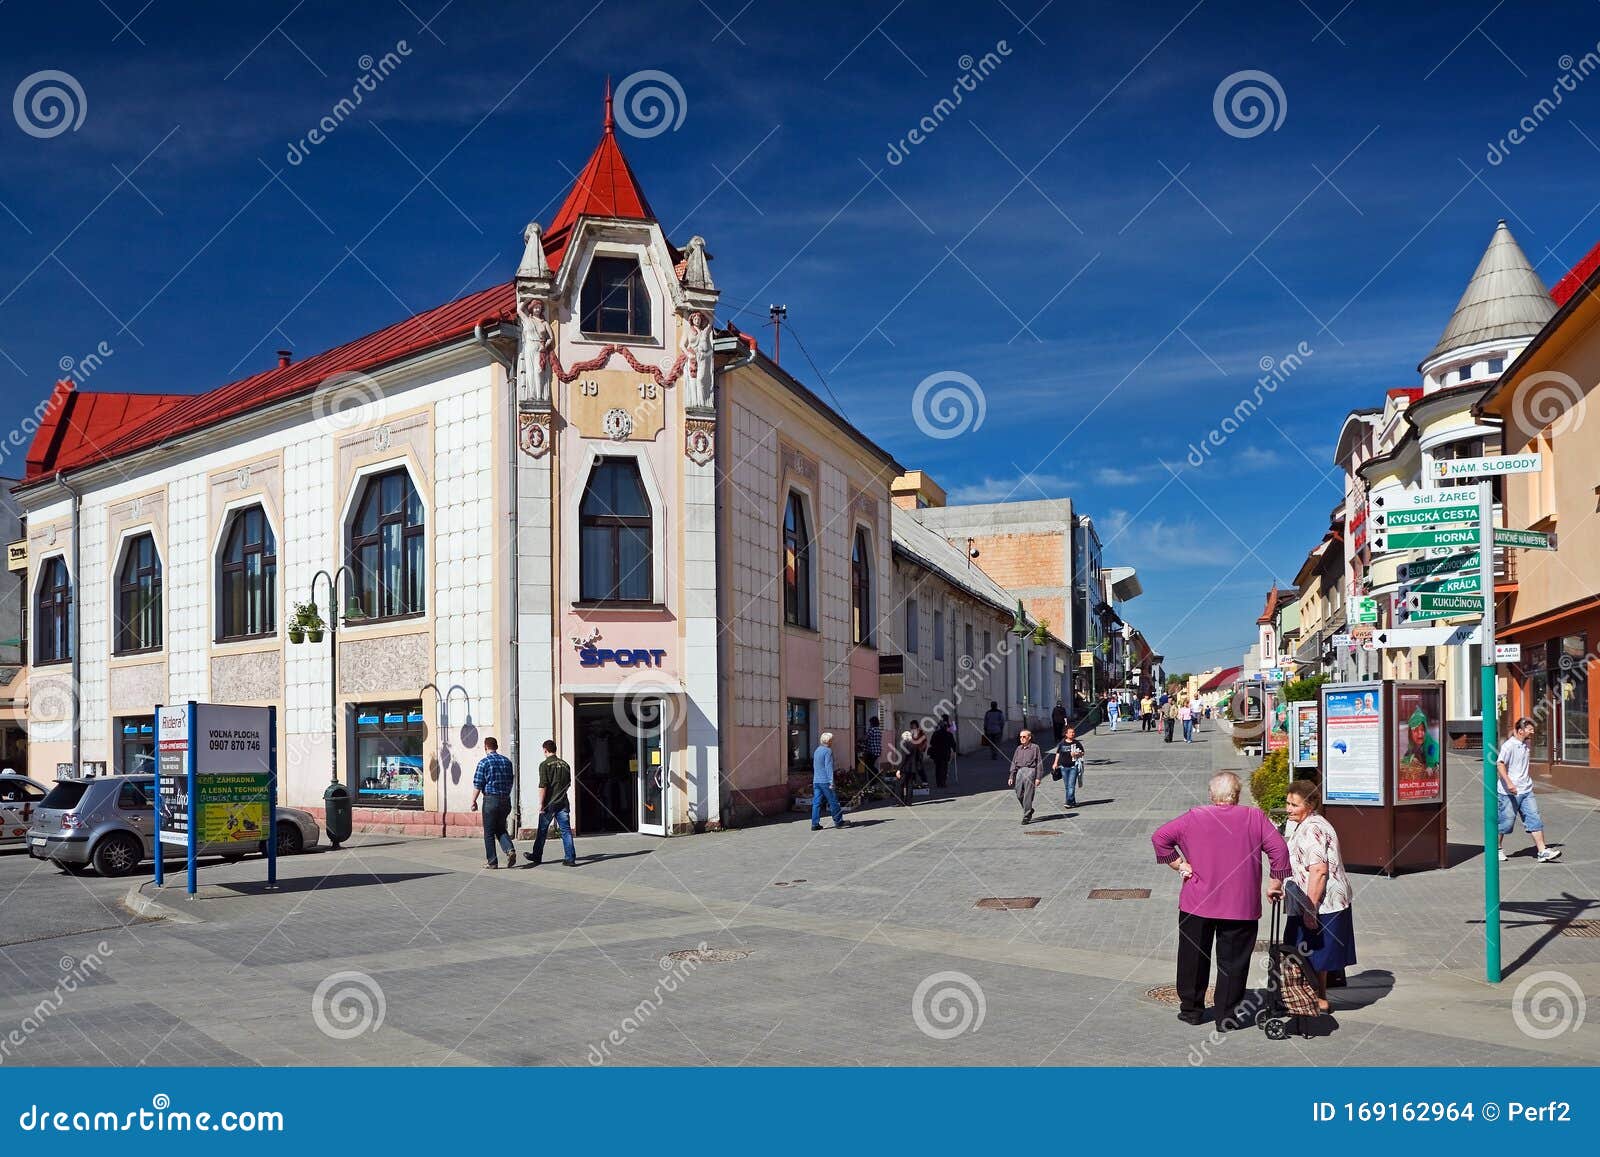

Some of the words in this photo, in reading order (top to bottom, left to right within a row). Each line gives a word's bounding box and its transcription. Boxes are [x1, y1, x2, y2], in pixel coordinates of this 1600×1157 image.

[580, 380, 599, 397] 19
[638, 383, 657, 400] 13
[1451, 463, 1479, 474] NÁM.
[1482, 459, 1537, 472] SLOBODY
[1439, 491, 1477, 502] ŽAREC
[1388, 510, 1440, 525] KYSUCKÁ
[1442, 509, 1479, 520] CESTA
[1434, 530, 1475, 543] HORNÁ
[1447, 579, 1478, 592] KRÁĽA
[1432, 596, 1483, 609] KUKUČÍNOVA
[1455, 631, 1475, 641] WC
[580, 647, 668, 668] SPORT
[233, 730, 260, 739] PLOCHA
[209, 740, 229, 751] 0907
[231, 740, 245, 751] 870
[247, 740, 260, 751] 746
